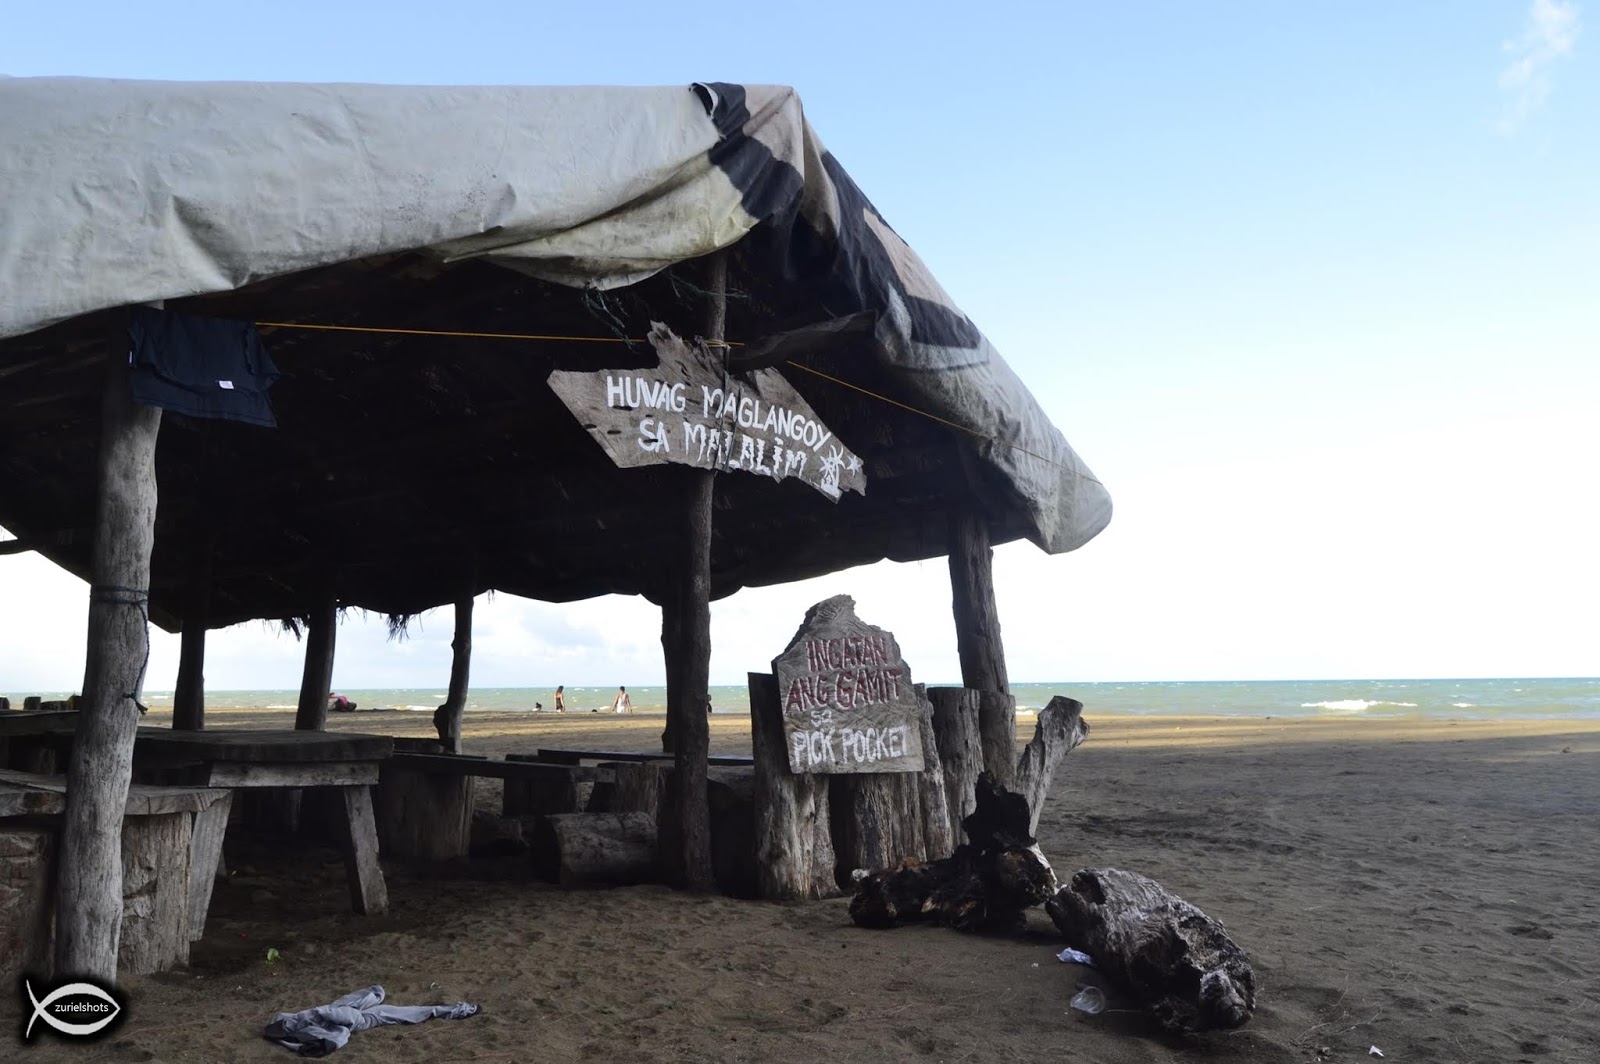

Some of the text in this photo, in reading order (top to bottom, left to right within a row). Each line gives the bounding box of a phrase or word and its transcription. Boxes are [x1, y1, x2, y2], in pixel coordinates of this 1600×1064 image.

[638, 418, 670, 452] SA
[702, 384, 831, 451] MAGLANGOY
[805, 636, 888, 673] INGATAN
[784, 669, 900, 715] ANG GAMIT
[790, 724, 910, 768] PICK POCKET
